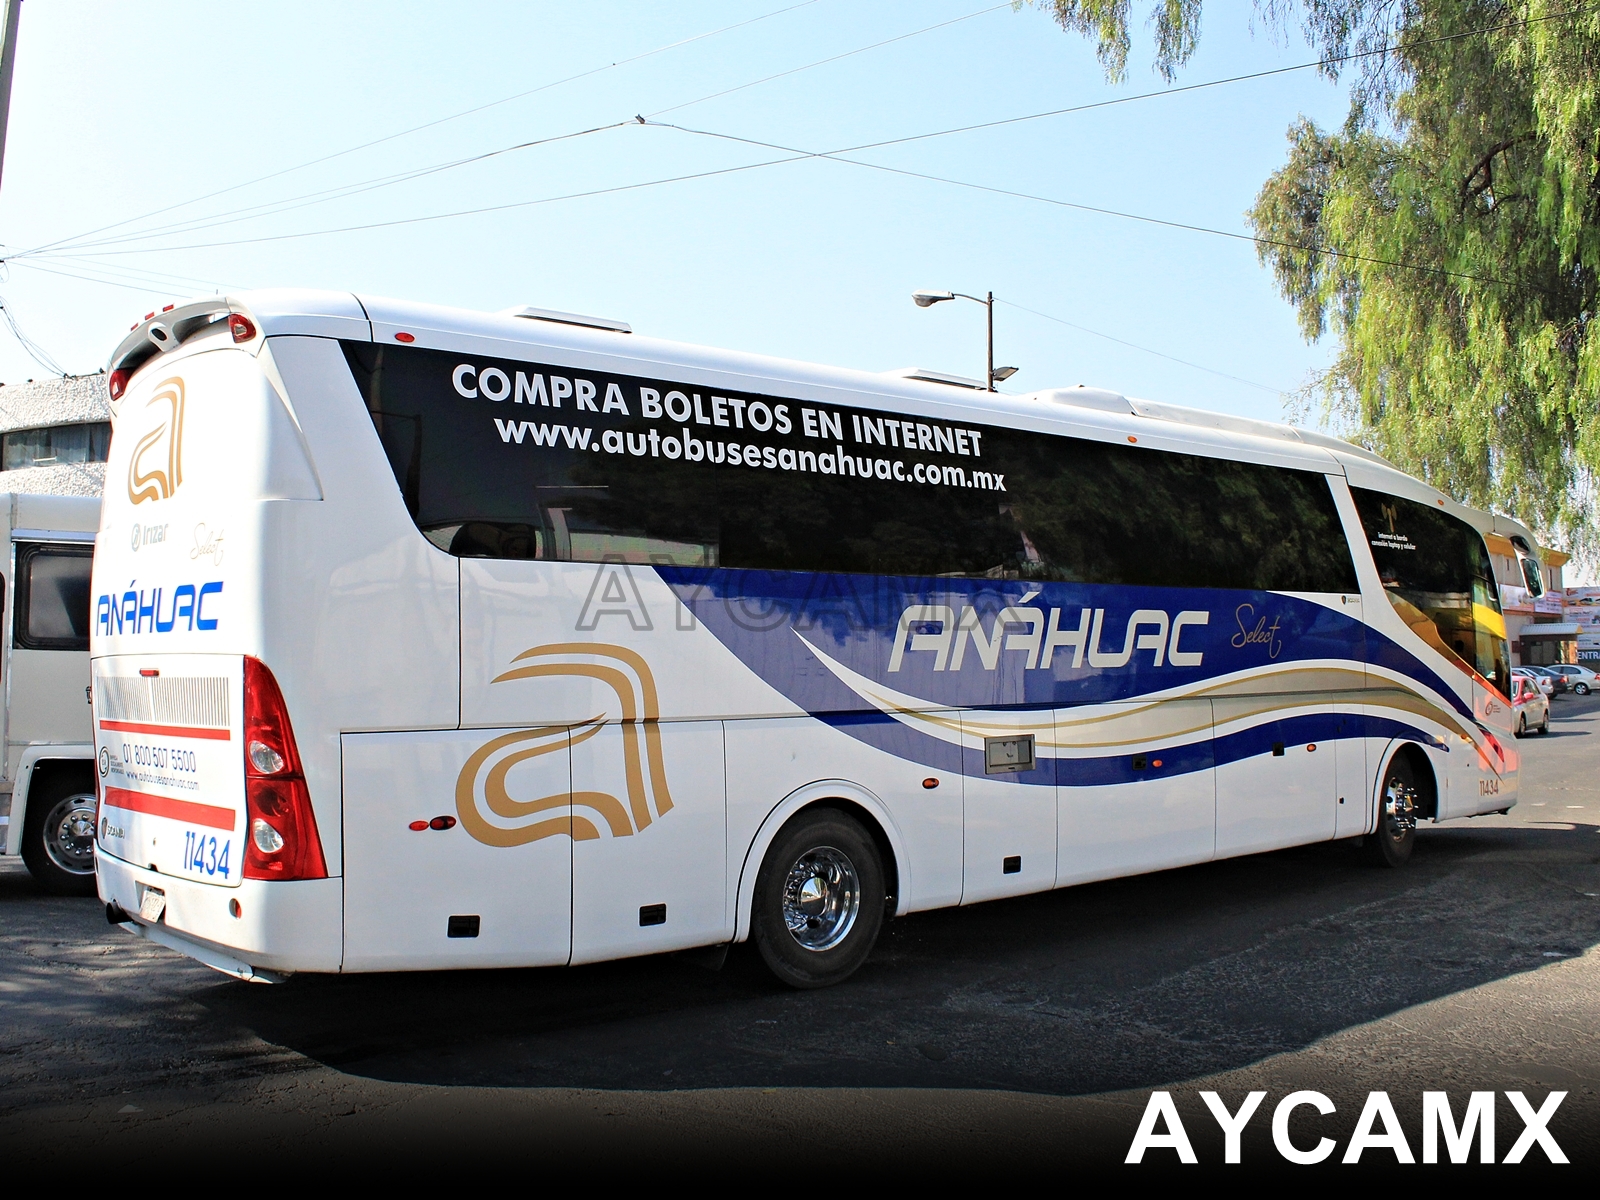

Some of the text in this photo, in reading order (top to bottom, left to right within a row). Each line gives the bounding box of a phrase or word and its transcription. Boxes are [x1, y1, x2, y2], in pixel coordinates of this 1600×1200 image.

[452, 363, 982, 457] COMPRA BOLETOS EN INTERNET
[493, 417, 1007, 492] www.autobusesanahuac.com.mx
[95, 579, 224, 637] ANÁHUAC
[887, 591, 1210, 673] ANÁHUAC
[1231, 603, 1282, 659] Select
[123, 743, 197, 773] 01 800 507 5500
[1479, 779, 1500, 796] 11434
[183, 830, 231, 880] 11434
